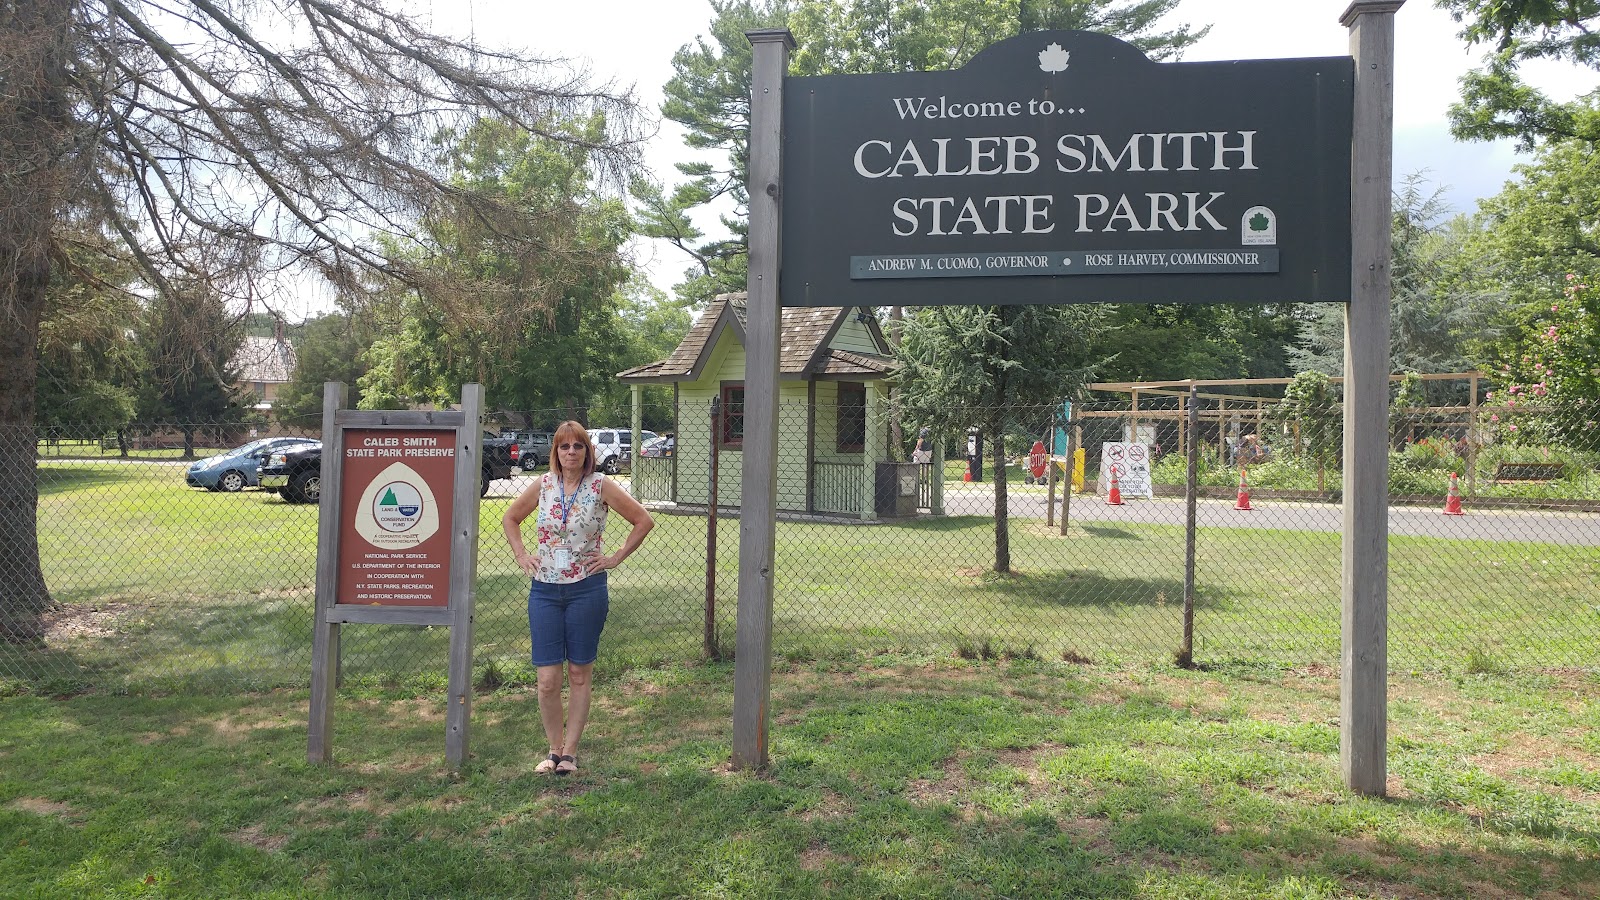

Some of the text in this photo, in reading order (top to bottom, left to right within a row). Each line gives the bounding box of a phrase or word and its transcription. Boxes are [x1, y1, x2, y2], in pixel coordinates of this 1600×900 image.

[892, 95, 1086, 120] Welcome to...
[853, 130, 1259, 179] CALEB SMITH
[892, 194, 1056, 236] STATE
[1073, 191, 1228, 232] PARK
[868, 255, 1049, 271] ANDREW M. CUOMO, GOVERNOR
[1085, 252, 1260, 268] ROSE HARVEY, COMMISSIONER
[364, 437, 436, 447] CALEB SMITH
[346, 447, 454, 458] STATE PARK PRESERVE
[1031, 453, 1046, 467] STOP
